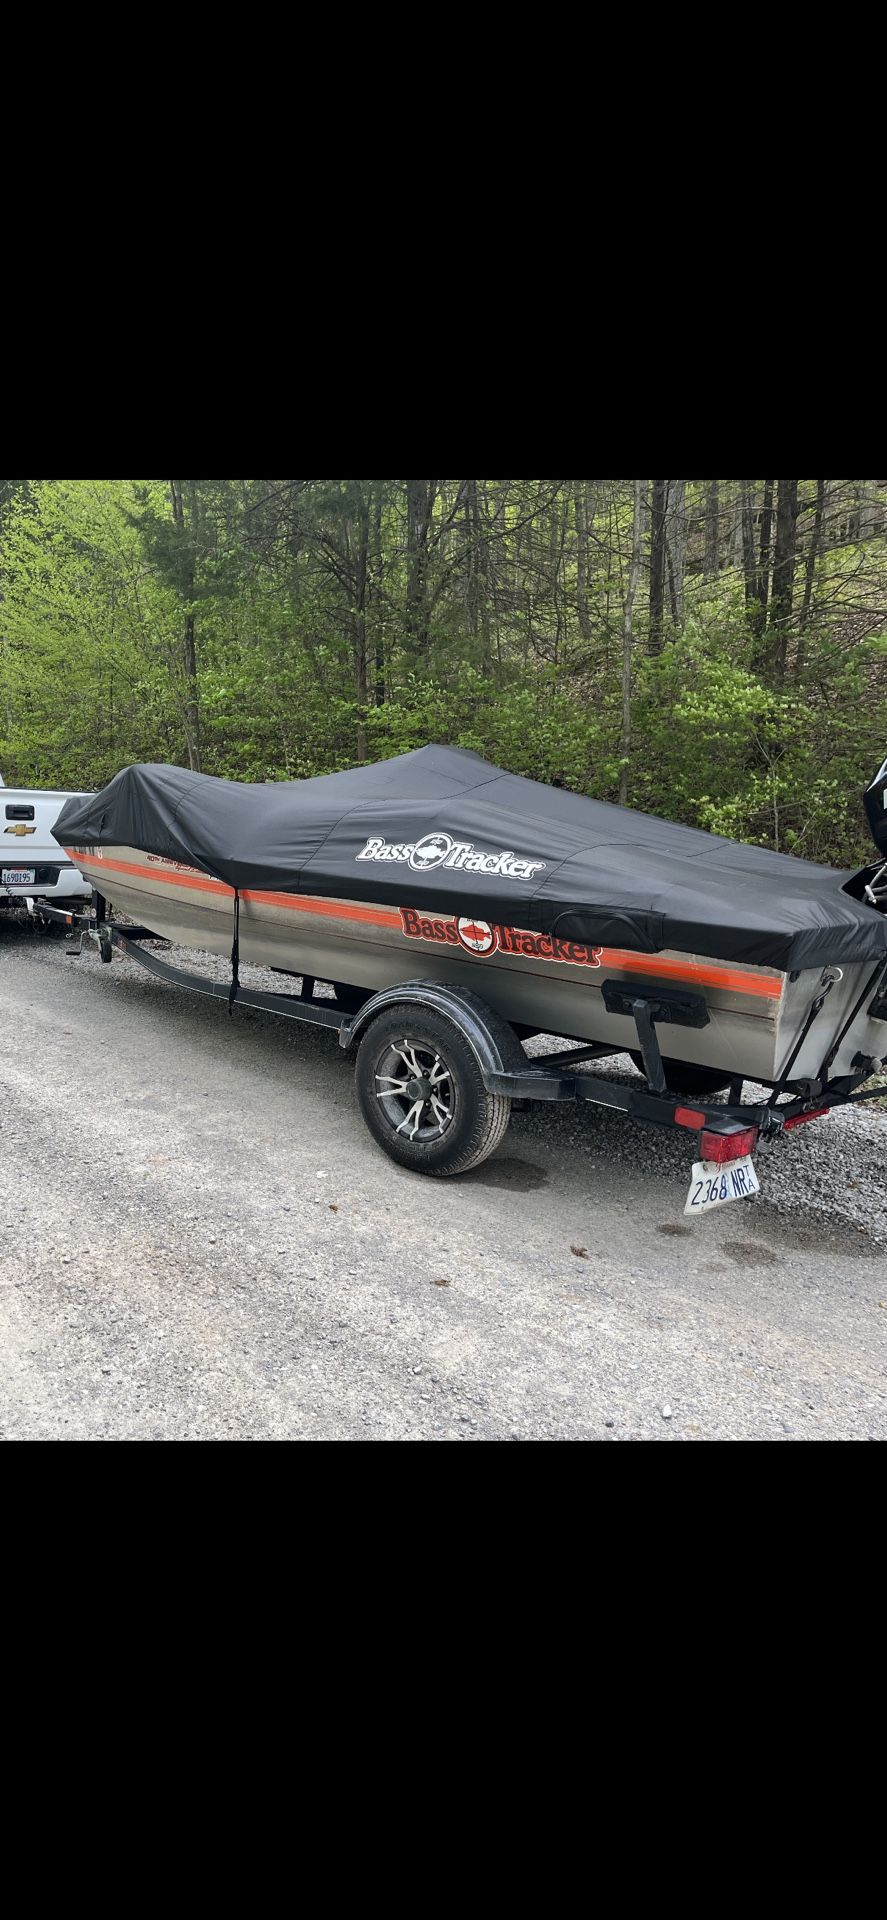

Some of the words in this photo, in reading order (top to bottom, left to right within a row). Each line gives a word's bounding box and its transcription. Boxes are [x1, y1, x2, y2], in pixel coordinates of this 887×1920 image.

[356, 837, 415, 862] Bass
[444, 842, 545, 879] Tracker
[400, 908, 459, 943] Bass
[497, 925, 601, 966] Tracker
[691, 1173, 728, 1205] 2368
